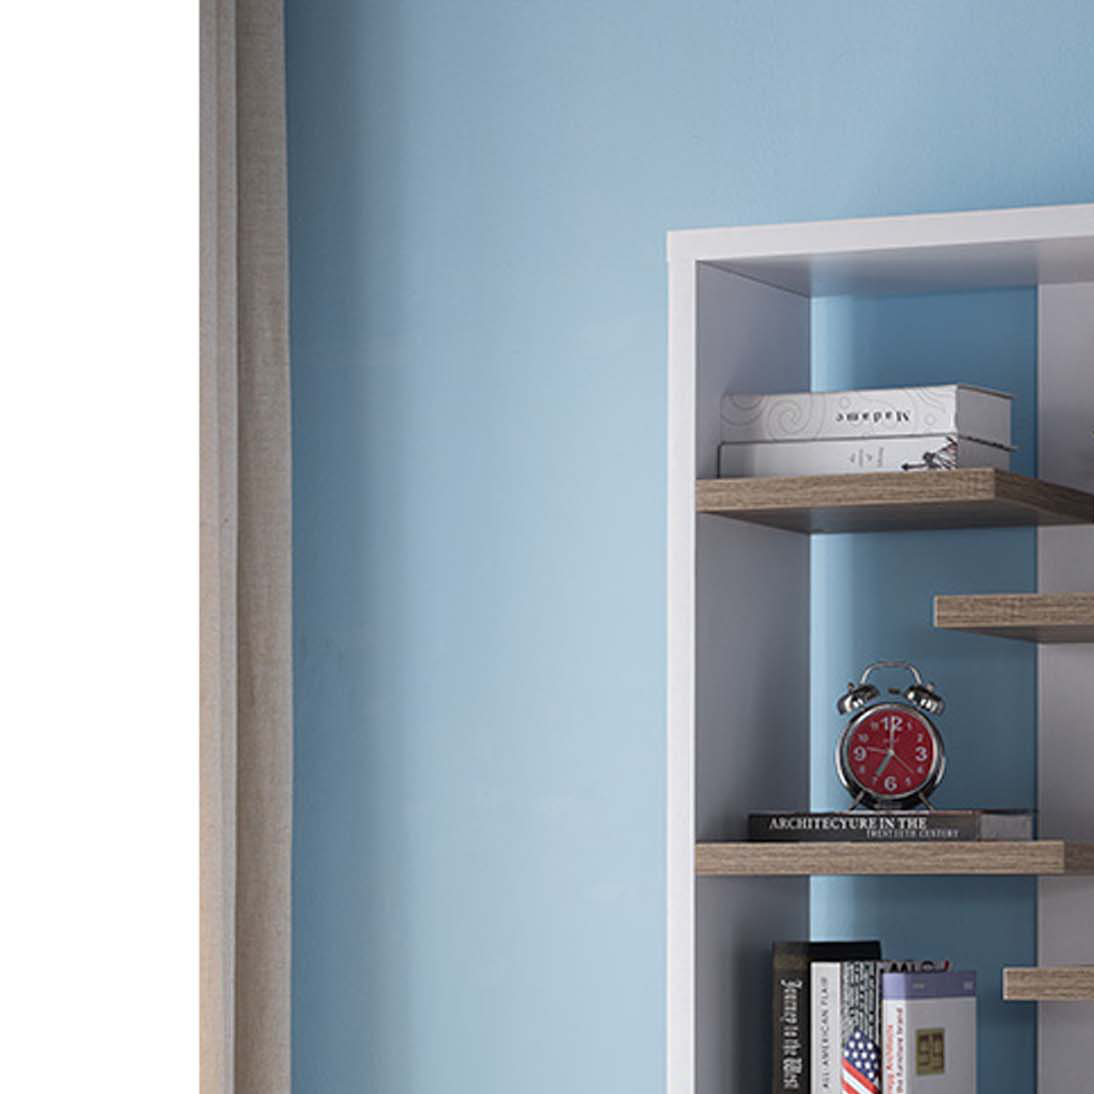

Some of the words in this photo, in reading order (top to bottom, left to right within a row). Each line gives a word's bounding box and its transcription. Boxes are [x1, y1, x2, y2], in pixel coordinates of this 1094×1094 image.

[836, 409, 911, 423] Madame
[881, 716, 903, 732] 12
[853, 747, 867, 762] 9
[914, 746, 928, 762] 3
[883, 776, 898, 791] 6
[879, 817, 896, 830] IN
[899, 817, 928, 830] THE
